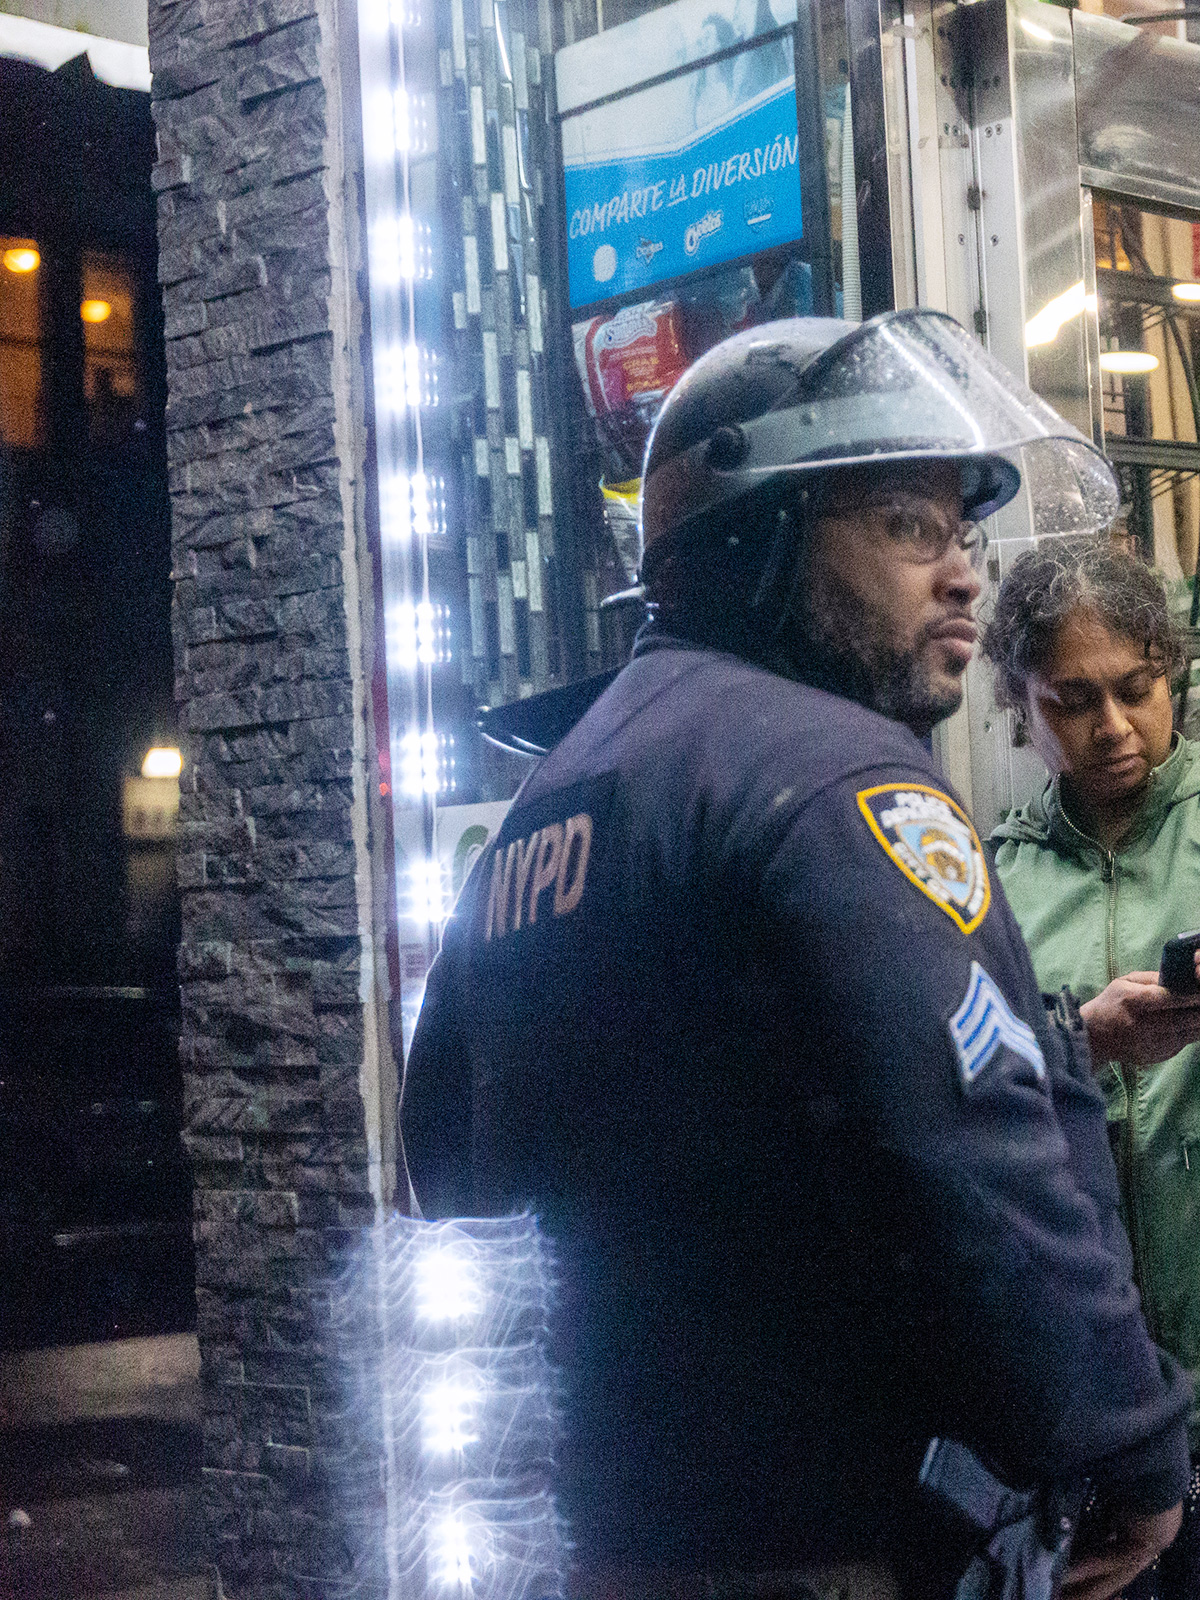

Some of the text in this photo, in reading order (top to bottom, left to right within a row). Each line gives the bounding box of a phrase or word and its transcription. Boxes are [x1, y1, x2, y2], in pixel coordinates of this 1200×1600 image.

[569, 134, 799, 240] COMPARTE LA DIVERSIÓN
[485, 812, 594, 942] NYPD
